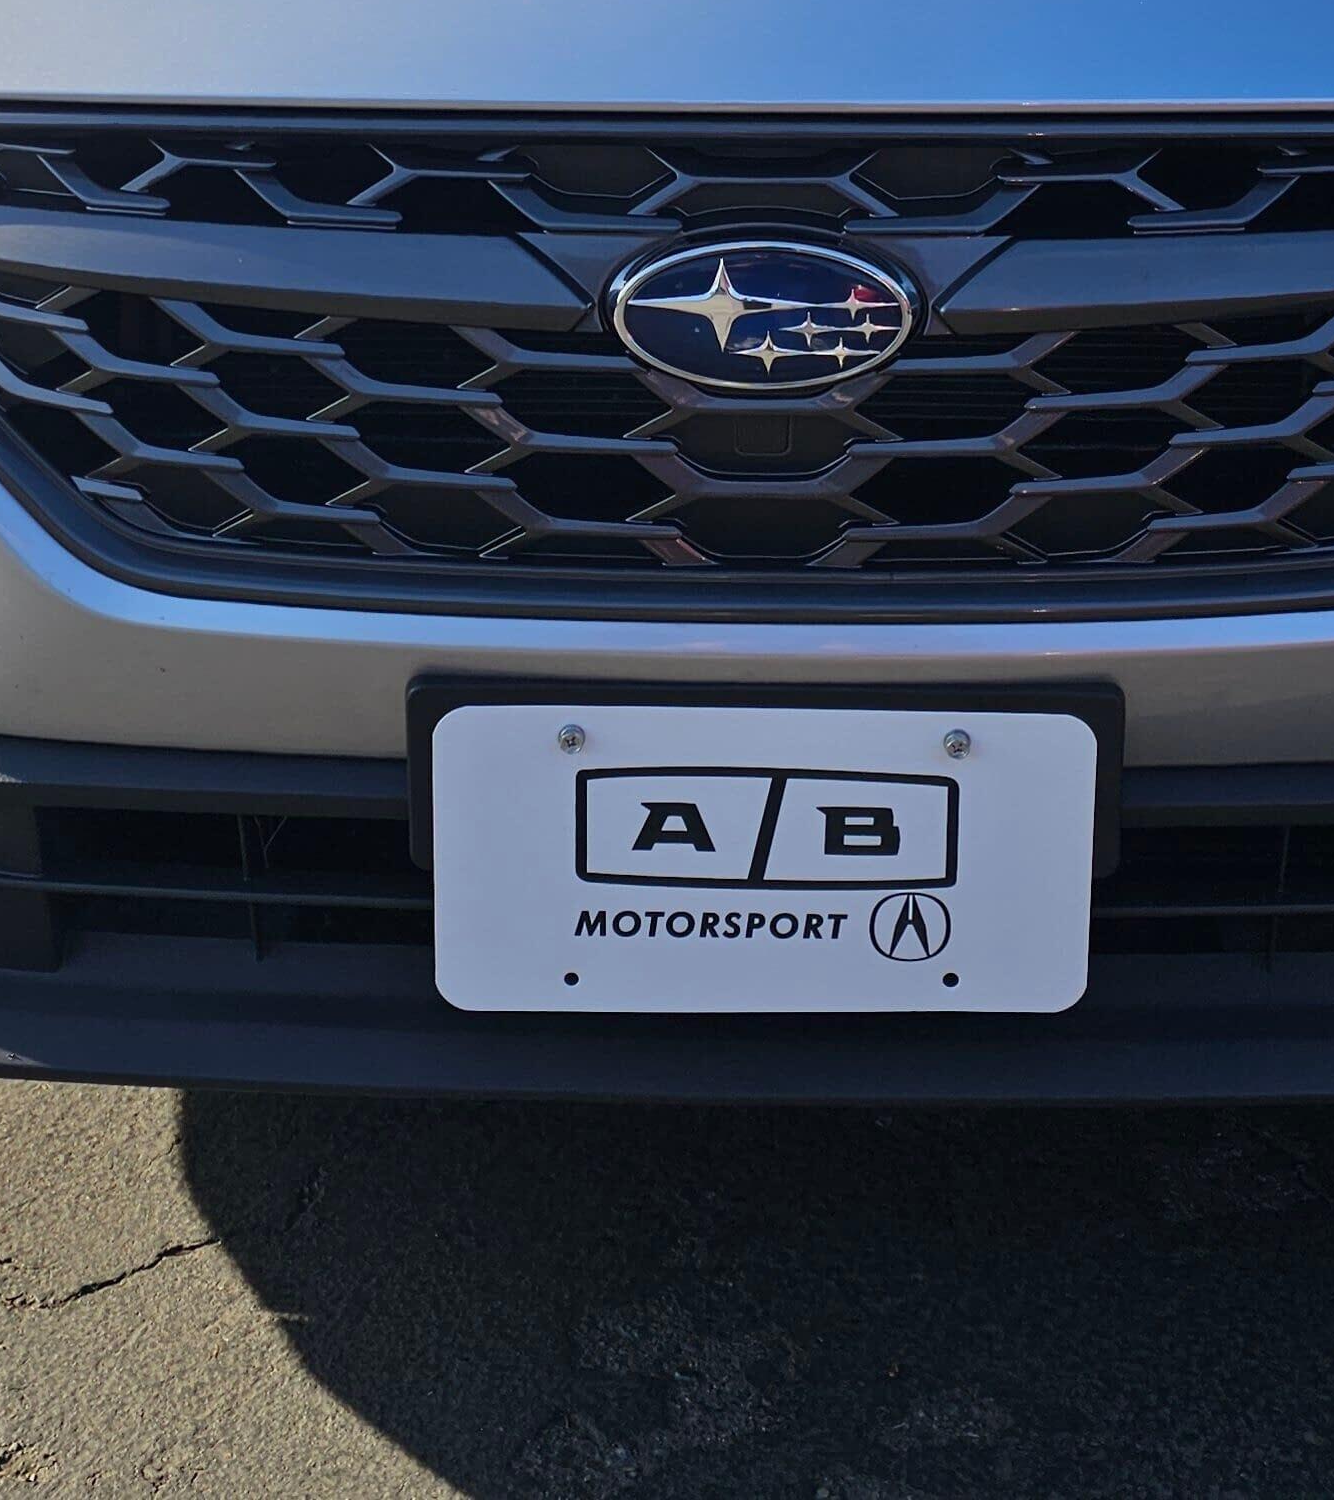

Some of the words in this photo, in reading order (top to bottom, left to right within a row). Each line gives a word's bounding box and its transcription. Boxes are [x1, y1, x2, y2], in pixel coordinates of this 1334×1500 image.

[631, 801, 716, 853] A
[816, 805, 901, 857] B
[573, 909, 849, 940] MOTORSPORT
